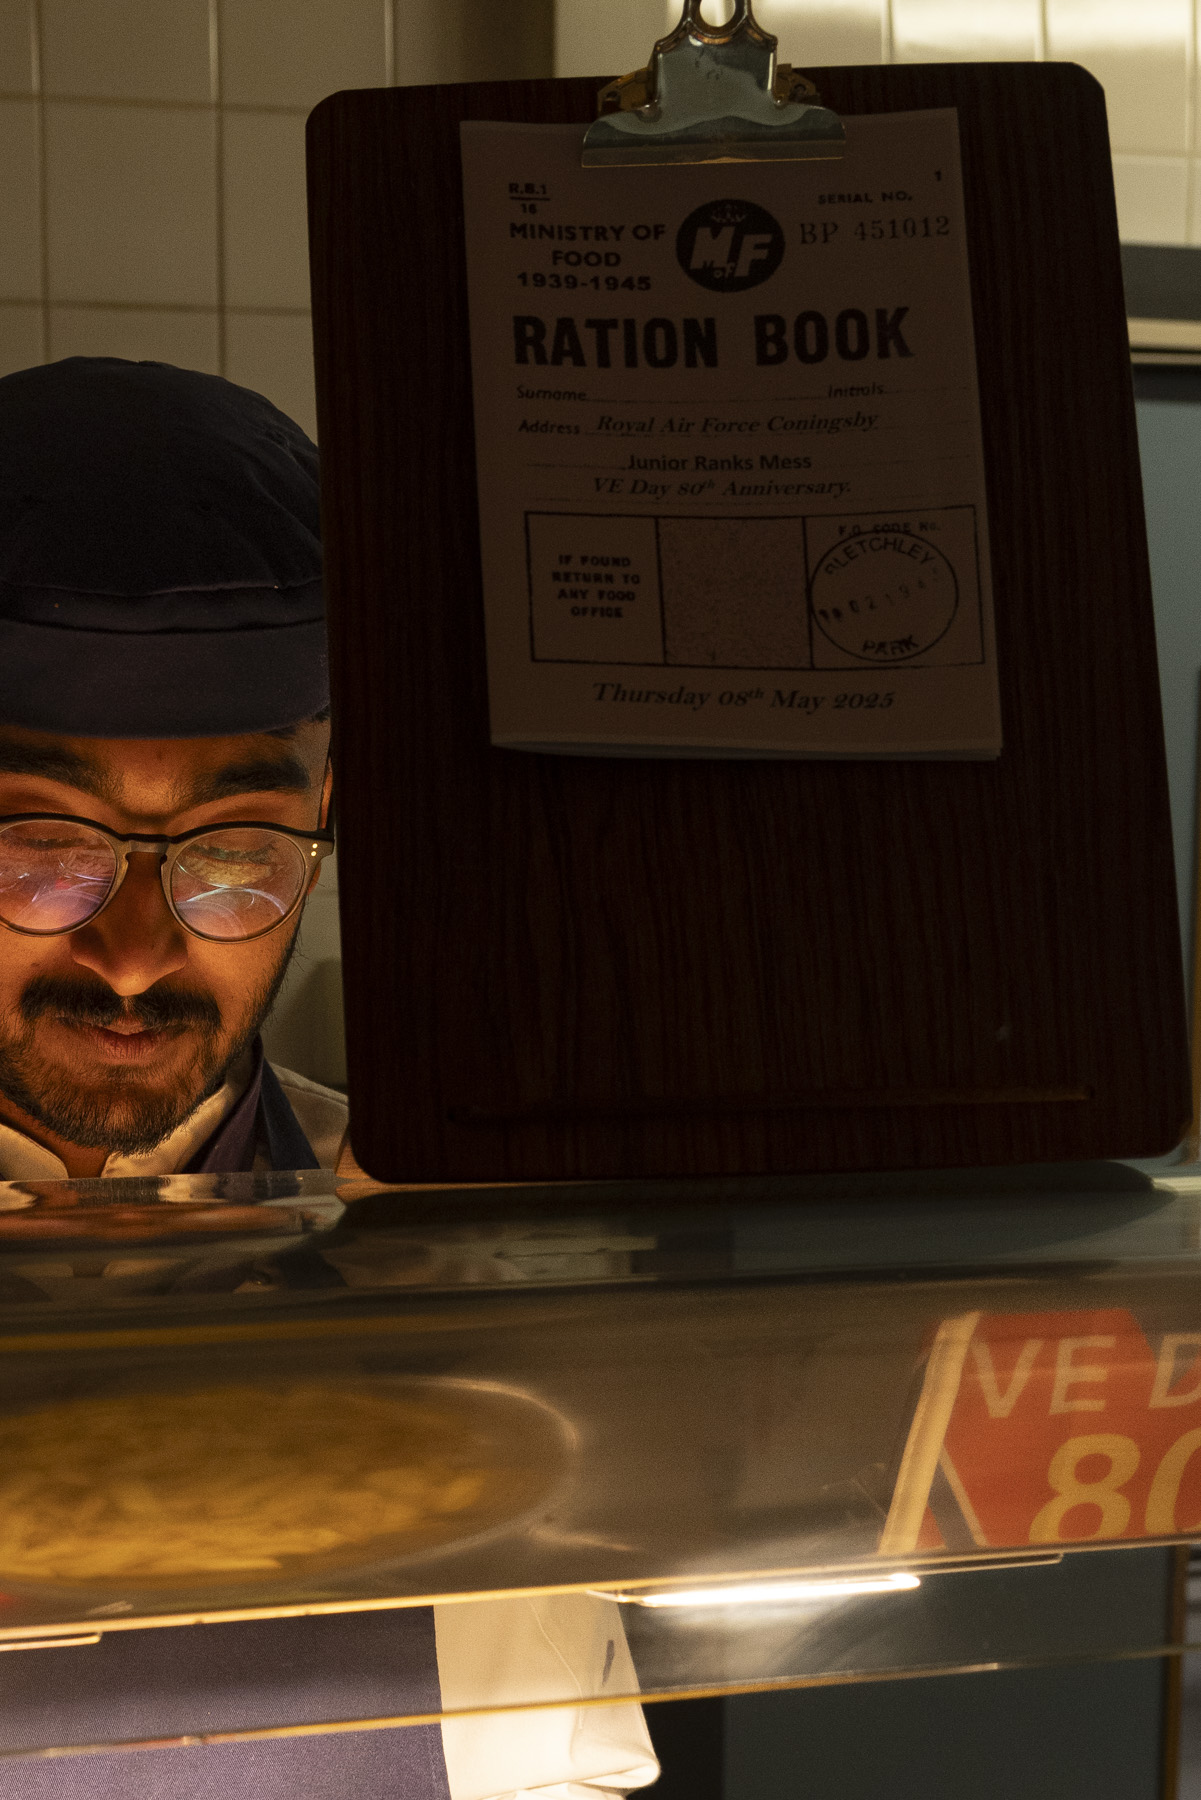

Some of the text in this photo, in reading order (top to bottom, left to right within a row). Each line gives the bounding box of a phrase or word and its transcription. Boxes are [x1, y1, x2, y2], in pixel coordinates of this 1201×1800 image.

[818, 192, 873, 204] SERIAL
[509, 222, 665, 241] MINISTRY OF
[800, 215, 950, 244] BP 451012
[552, 250, 621, 267] FOOD
[517, 271, 651, 291] 1939-1945
[512, 306, 915, 368] RATION BOOK
[516, 385, 587, 401] Surname
[518, 419, 580, 435] Address
[596, 411, 878, 436] Royal Air Force Coningsby
[628, 454, 812, 471] Junior Ranks Mess
[593, 477, 624, 494] VE
[629, 479, 671, 499] Day
[558, 554, 631, 567] IF FOUND
[552, 571, 641, 584] RETURN TO
[557, 588, 636, 601] ANY FOOD
[570, 606, 623, 618] OFFICE
[862, 635, 919, 656] PARK
[592, 682, 712, 711] Thursday
[769, 689, 825, 714] May
[832, 690, 896, 710] 2025
[970, 1334, 1117, 1419] VE
